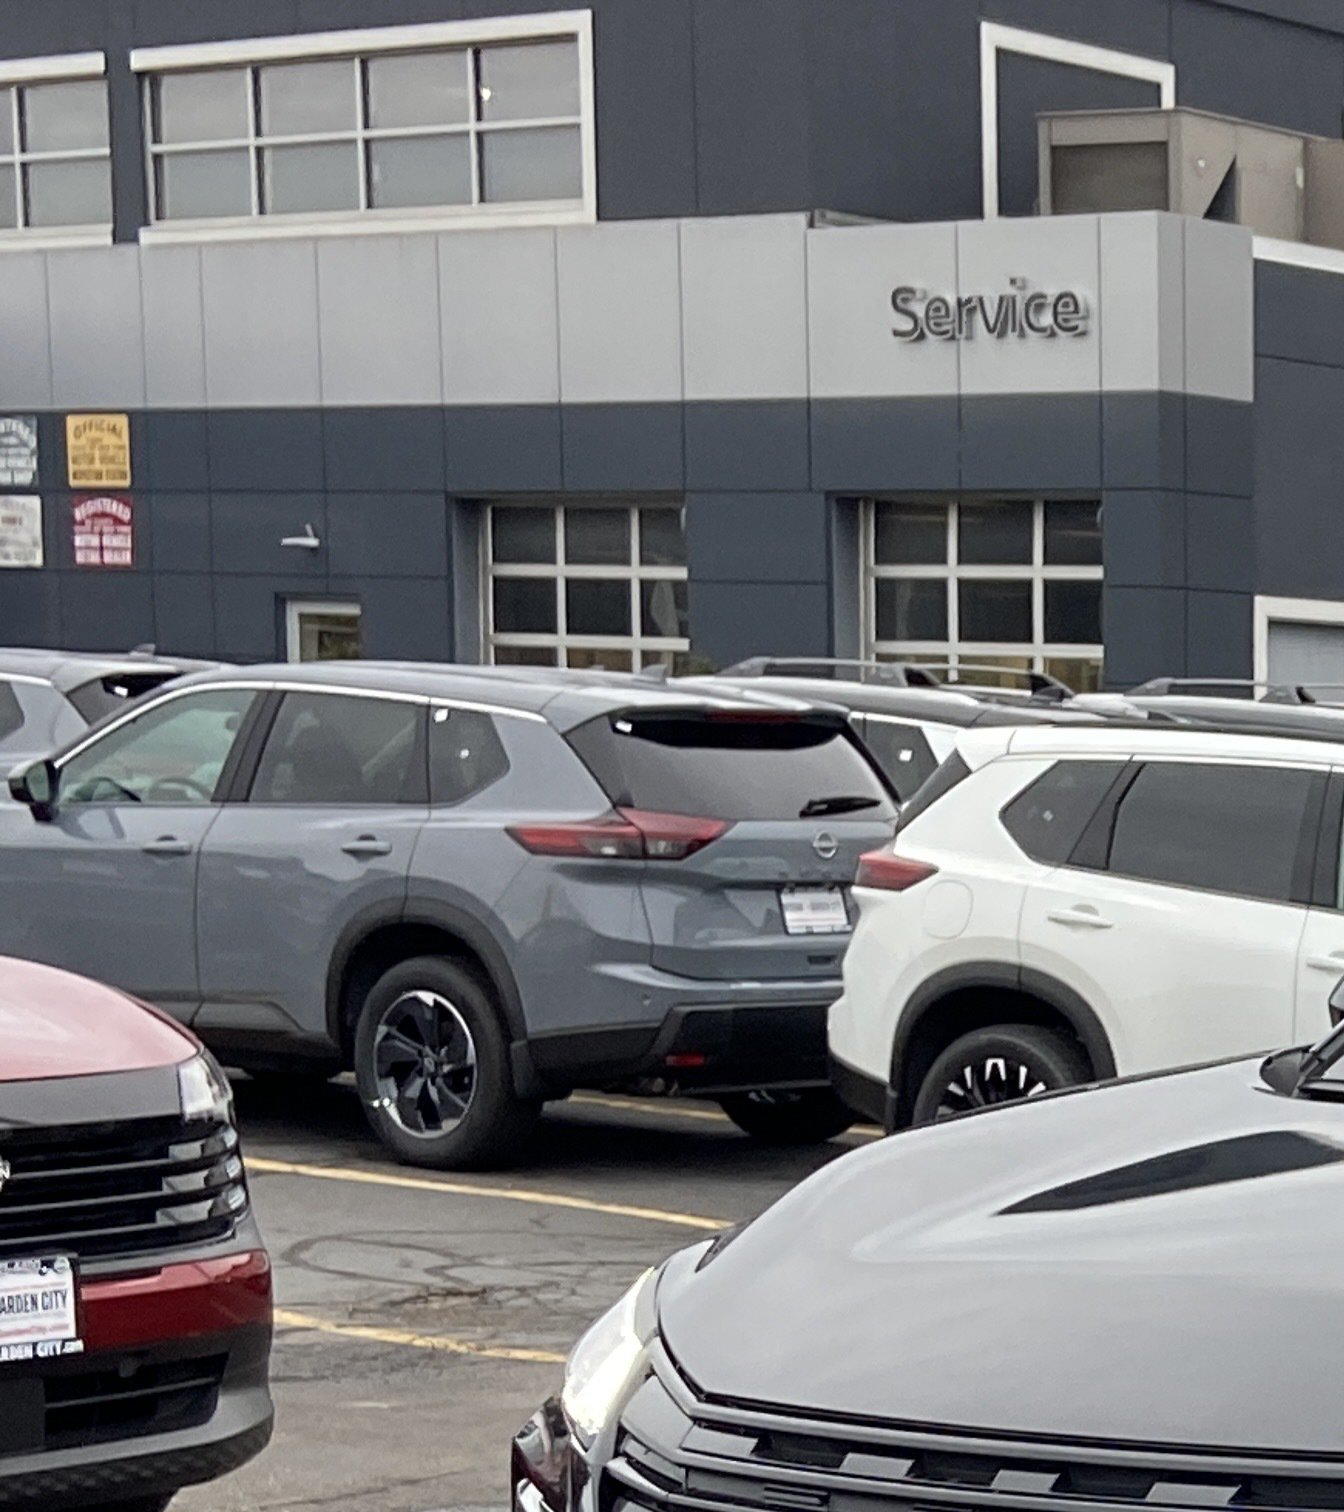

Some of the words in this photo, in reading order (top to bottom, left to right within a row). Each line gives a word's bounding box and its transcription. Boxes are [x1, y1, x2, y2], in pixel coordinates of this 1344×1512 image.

[891, 277, 1085, 338] Service
[73, 419, 123, 439] OFFICIAL
[41, 1289, 67, 1311] CITY
